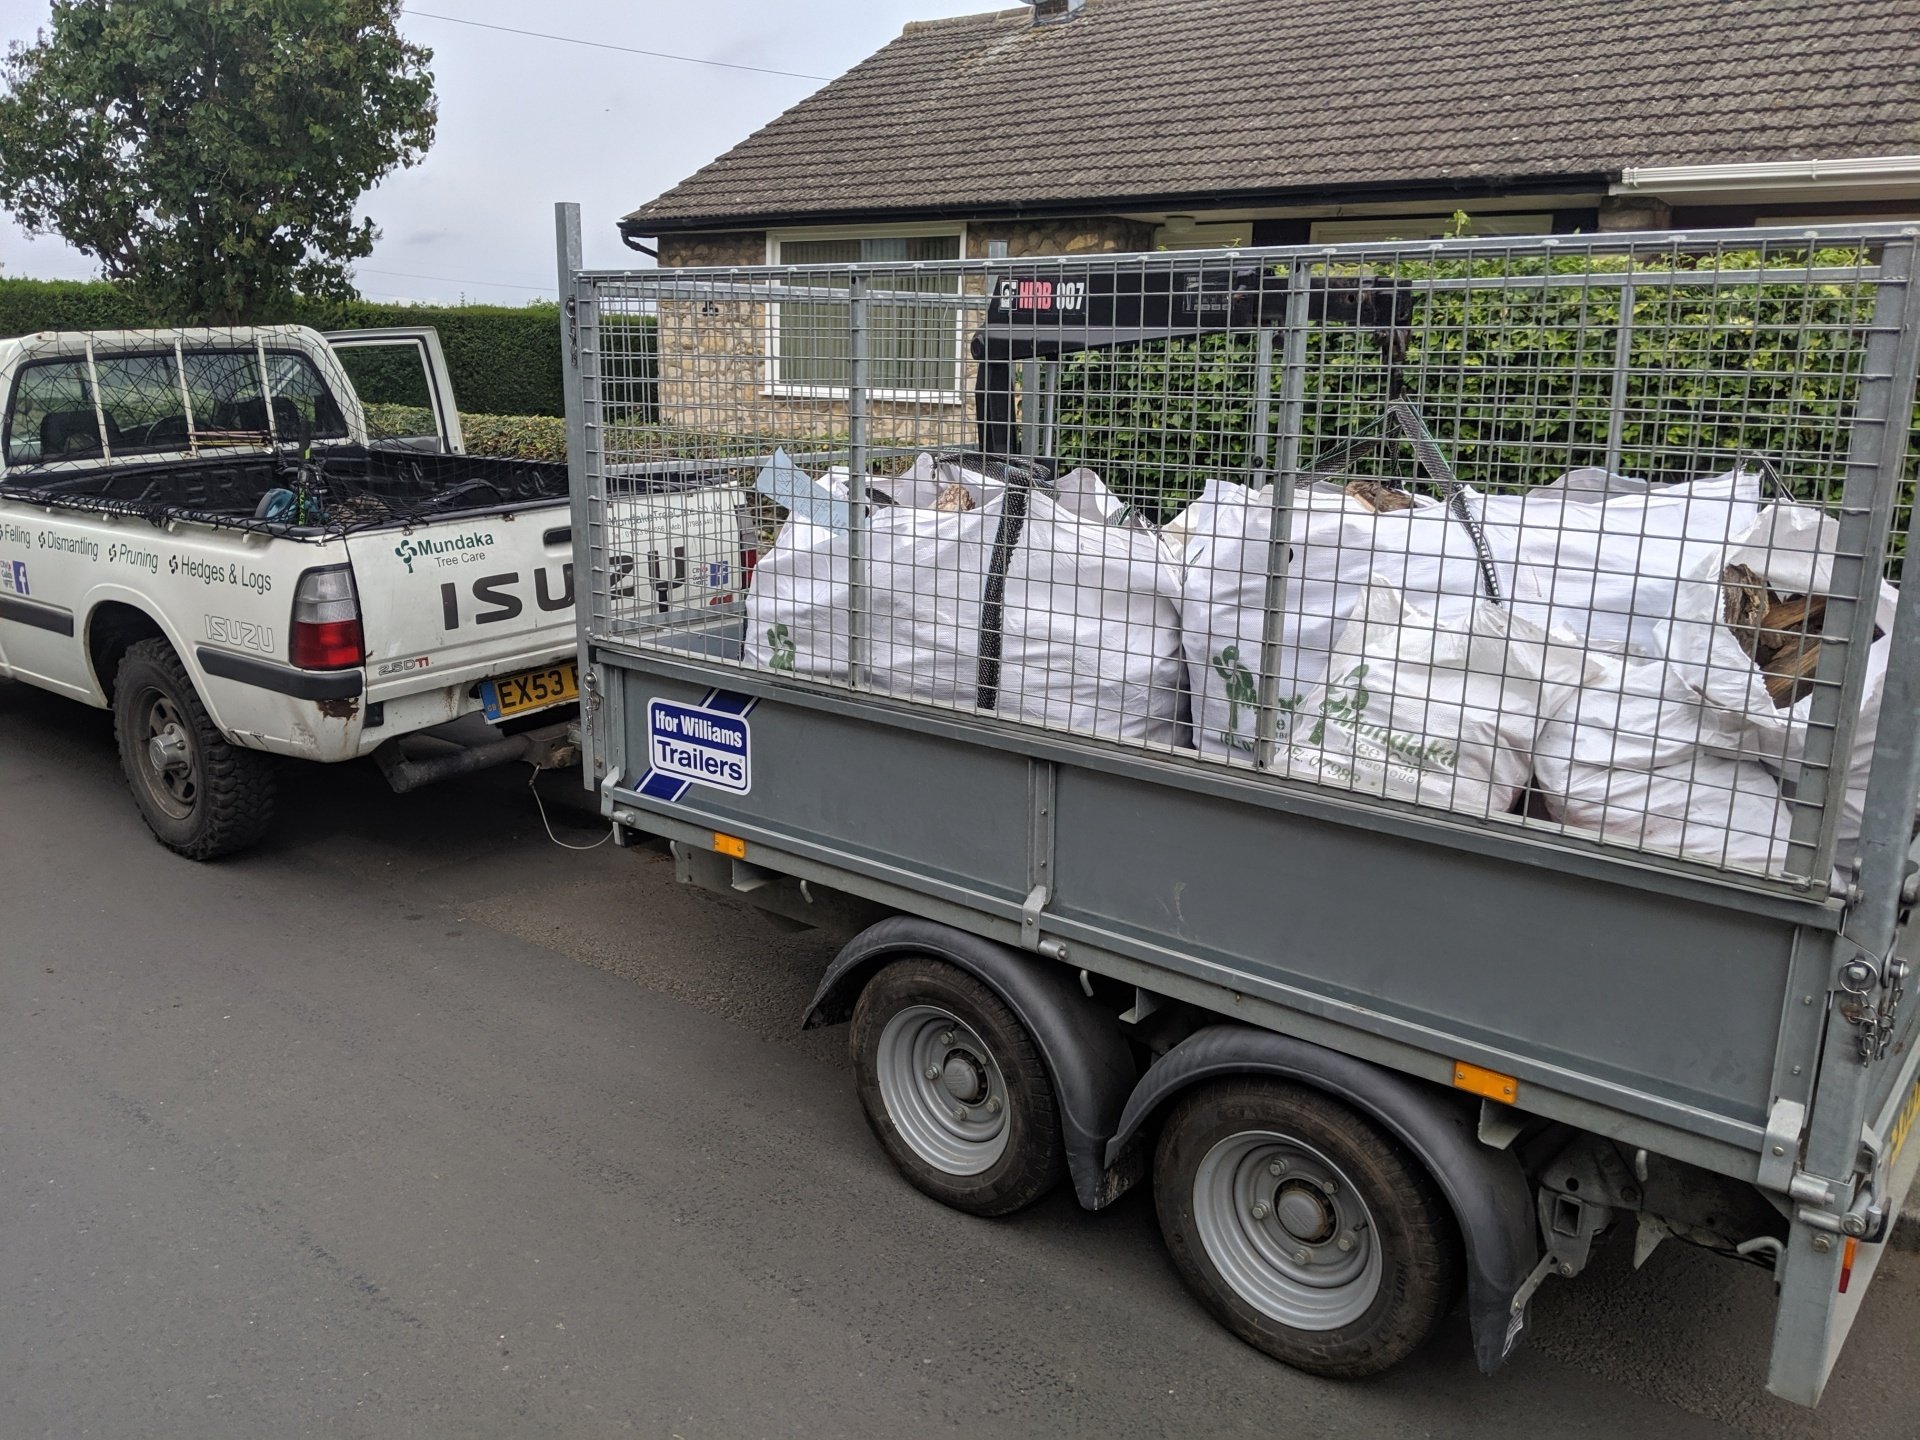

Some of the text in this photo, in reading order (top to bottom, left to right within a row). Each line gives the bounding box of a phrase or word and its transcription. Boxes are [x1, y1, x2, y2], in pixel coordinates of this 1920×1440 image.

[1019, 281, 1085, 310] HIAB 007
[5, 524, 272, 595] Felling Dismantling Pruning Hedges & Logs
[417, 532, 494, 556] Mundaka
[434, 552, 486, 568] Tree Care
[440, 546, 686, 631] ISUZU
[204, 614, 275, 654] ISUZU
[497, 669, 565, 709] EX53
[655, 709, 743, 748] Ifor Williams
[1333, 707, 1460, 768] Mundaka
[1345, 731, 1380, 759] Tee
[657, 739, 743, 781] Trailers
